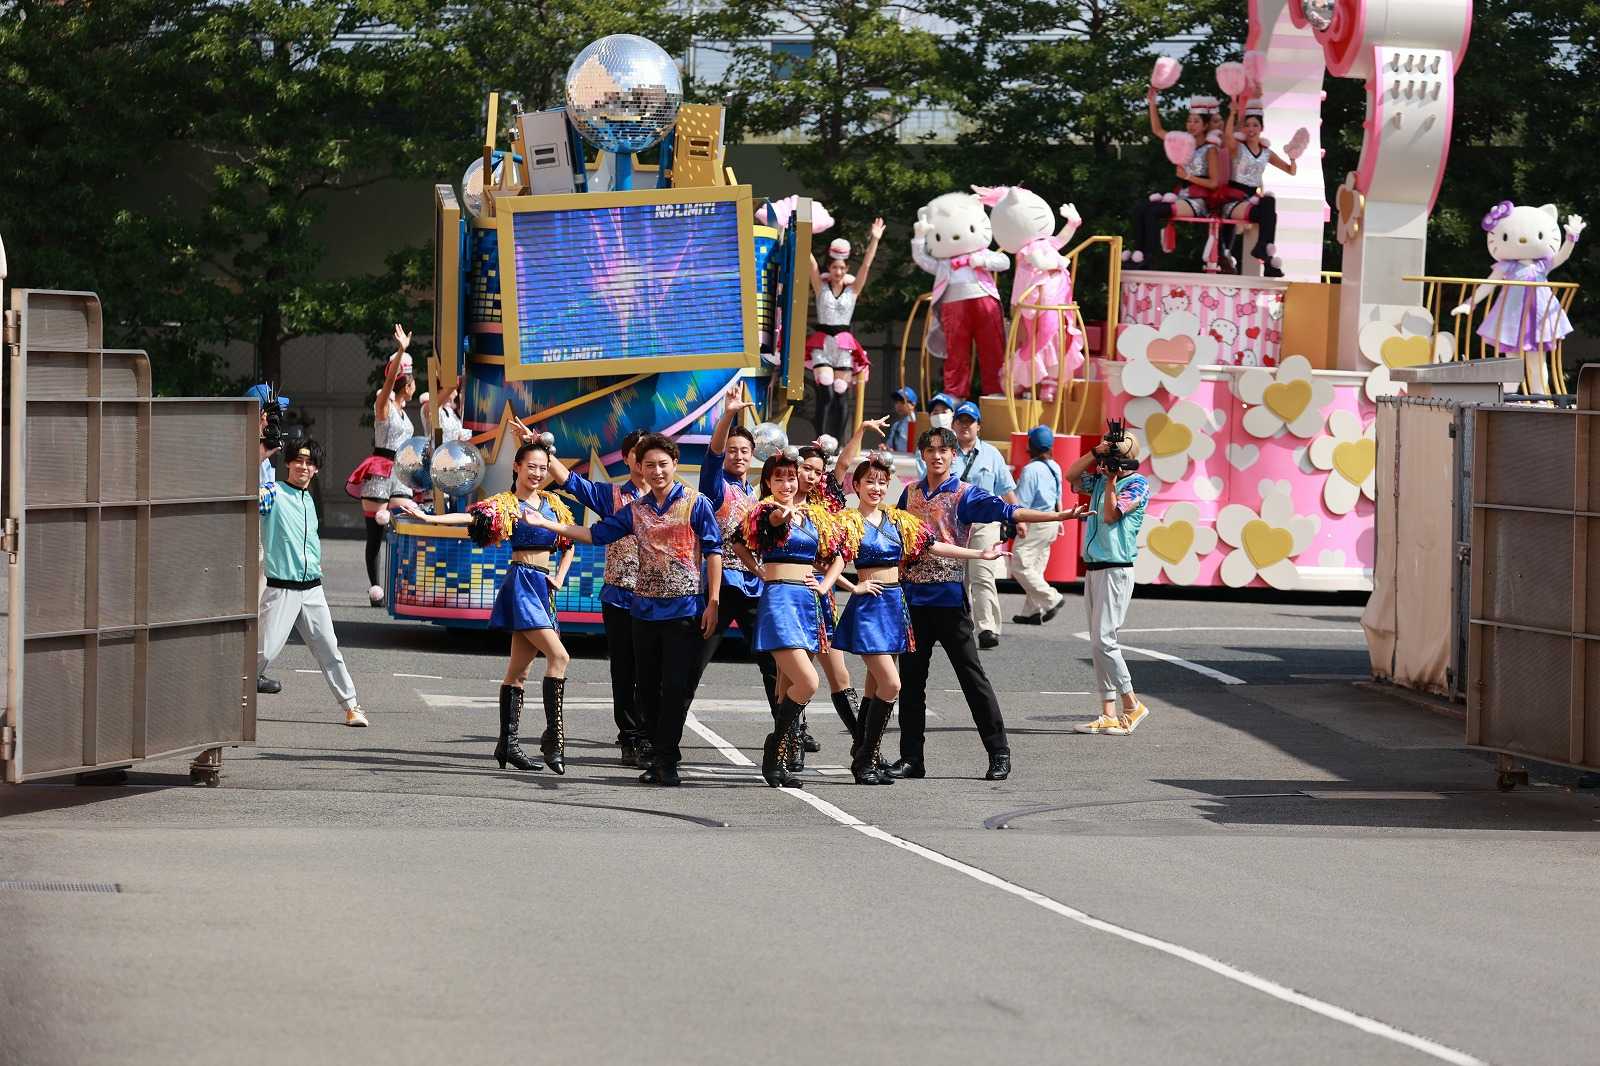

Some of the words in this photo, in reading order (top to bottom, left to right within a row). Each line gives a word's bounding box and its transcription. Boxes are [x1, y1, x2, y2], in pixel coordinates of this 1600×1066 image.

[655, 204, 674, 218] NO
[675, 202, 716, 216] LIMIT!
[543, 348, 561, 362] NO
